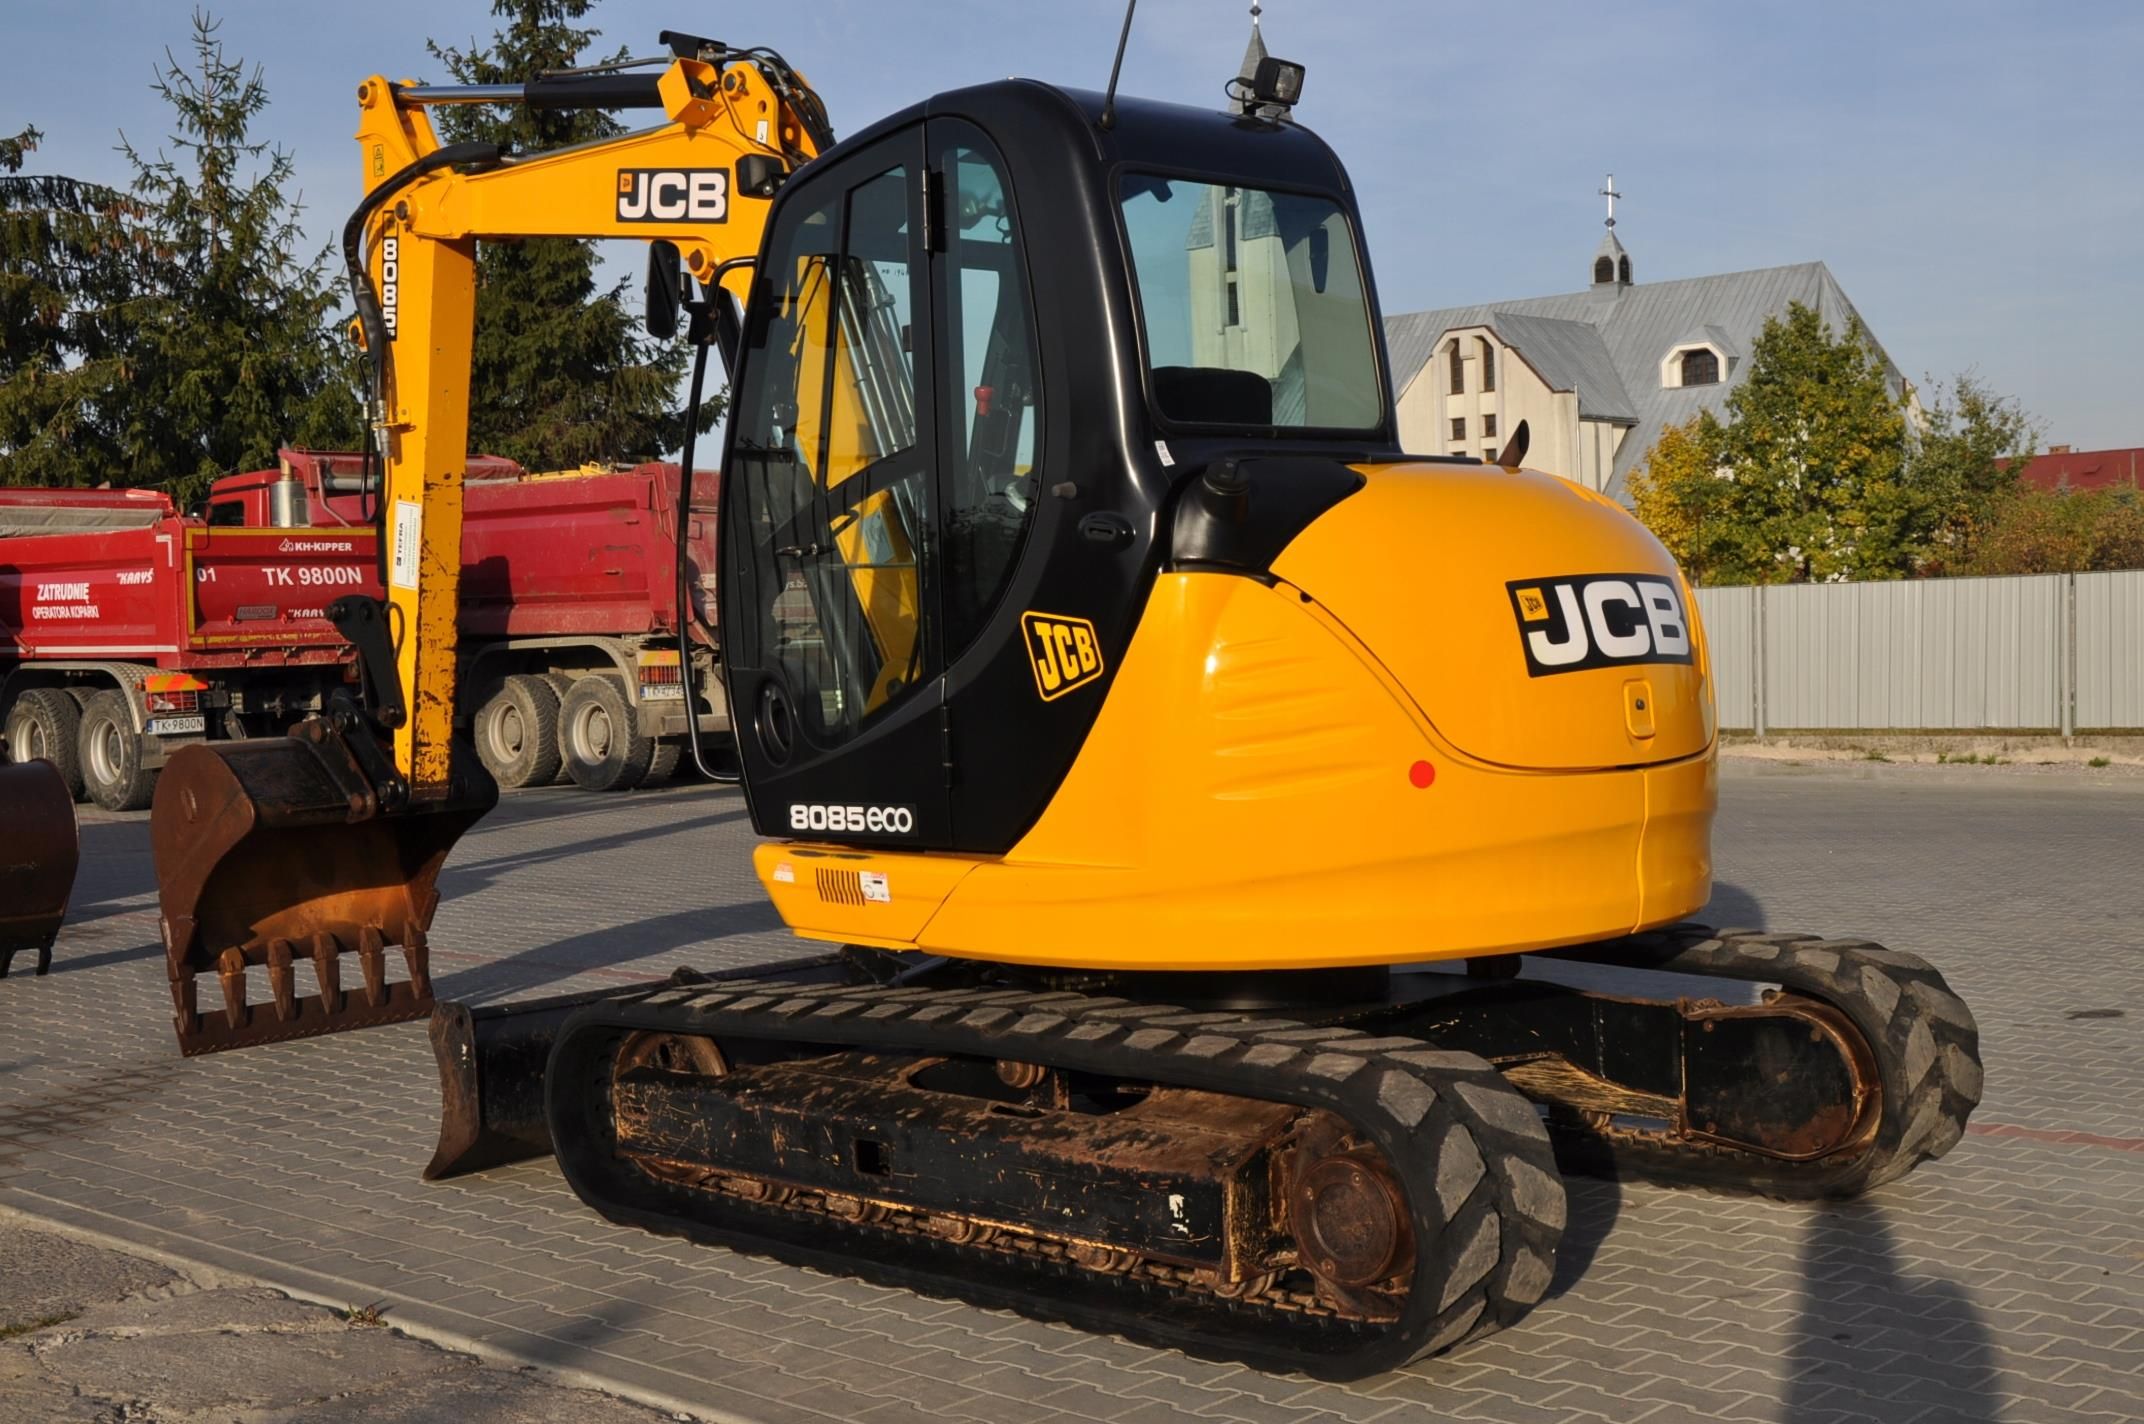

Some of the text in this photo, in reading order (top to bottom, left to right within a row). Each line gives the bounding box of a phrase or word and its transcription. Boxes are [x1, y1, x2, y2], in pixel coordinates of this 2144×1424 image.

[619, 172, 726, 219] JCB
[383, 238, 397, 329] 8085
[295, 542, 352, 551] KH-KIPPER
[262, 567, 363, 586] TK 9800N
[36, 582, 90, 604] ZATRUDNIĘ
[32, 605, 100, 619] OPERATORA KOPARKI
[1527, 580, 1689, 666] JCB
[1033, 621, 1097, 691] JCB
[155, 718, 203, 731] TK 9800N
